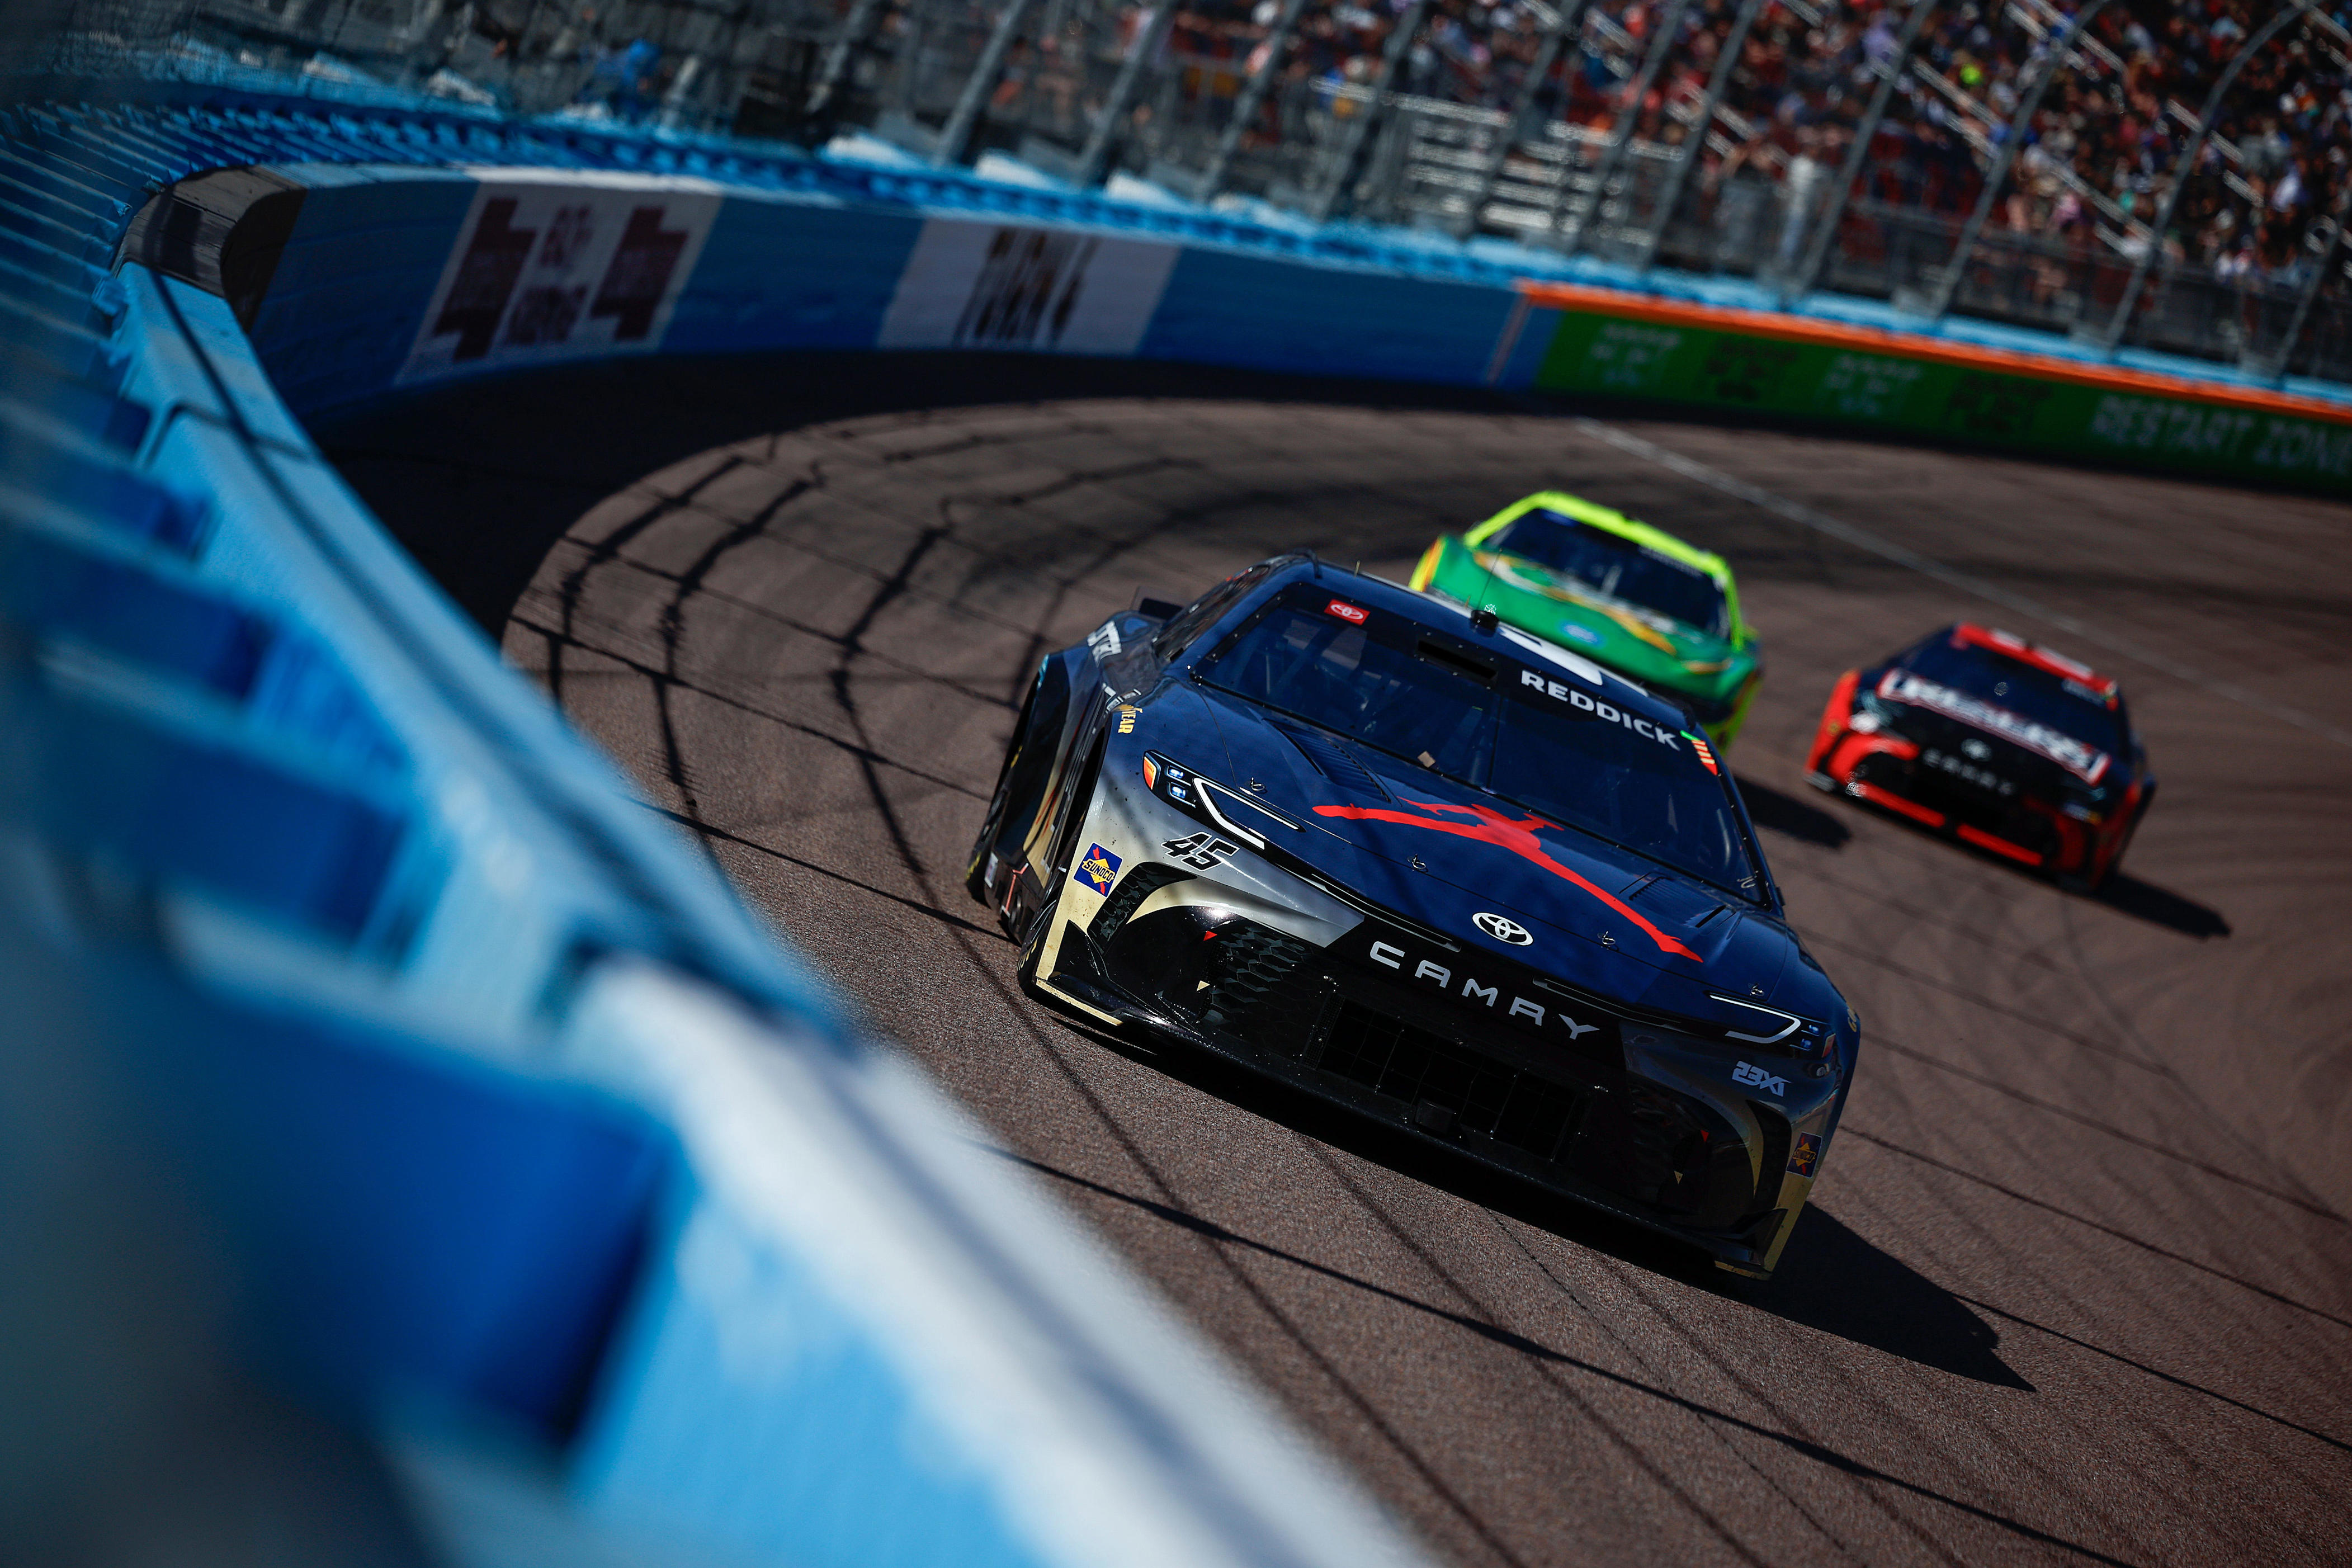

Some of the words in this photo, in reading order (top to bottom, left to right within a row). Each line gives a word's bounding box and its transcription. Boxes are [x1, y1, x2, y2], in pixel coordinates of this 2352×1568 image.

[1521, 669, 1680, 752] REDDICK
[1083, 860, 1114, 881] SUNOCO
[1160, 832, 1240, 871] 45
[1369, 941, 1600, 1040] CAMRY
